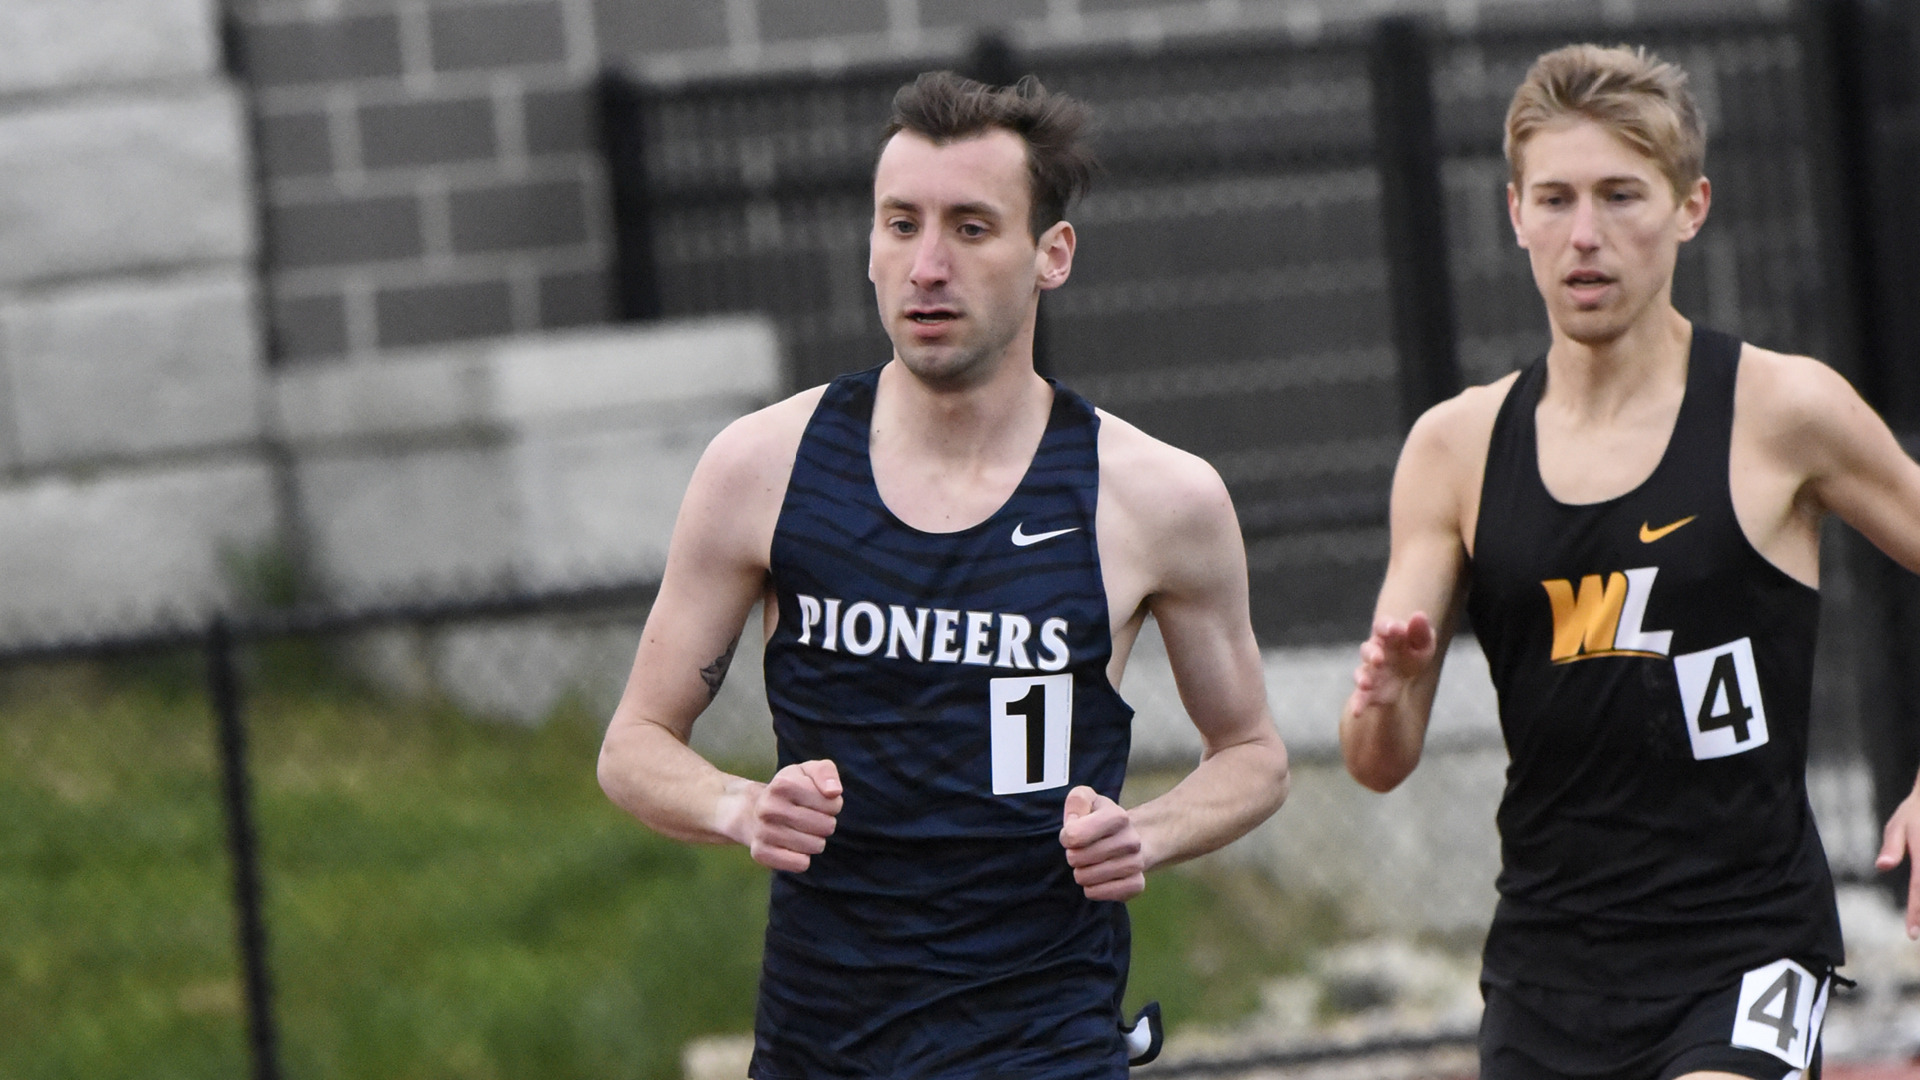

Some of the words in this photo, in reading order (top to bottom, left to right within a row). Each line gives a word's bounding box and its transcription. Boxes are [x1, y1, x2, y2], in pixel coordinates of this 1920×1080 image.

[797, 593, 1070, 671] PIONEERS
[1541, 566, 1674, 661] WL
[1006, 684, 1046, 785] 1
[1698, 652, 1754, 744] 4
[1748, 968, 1802, 1052] 4
